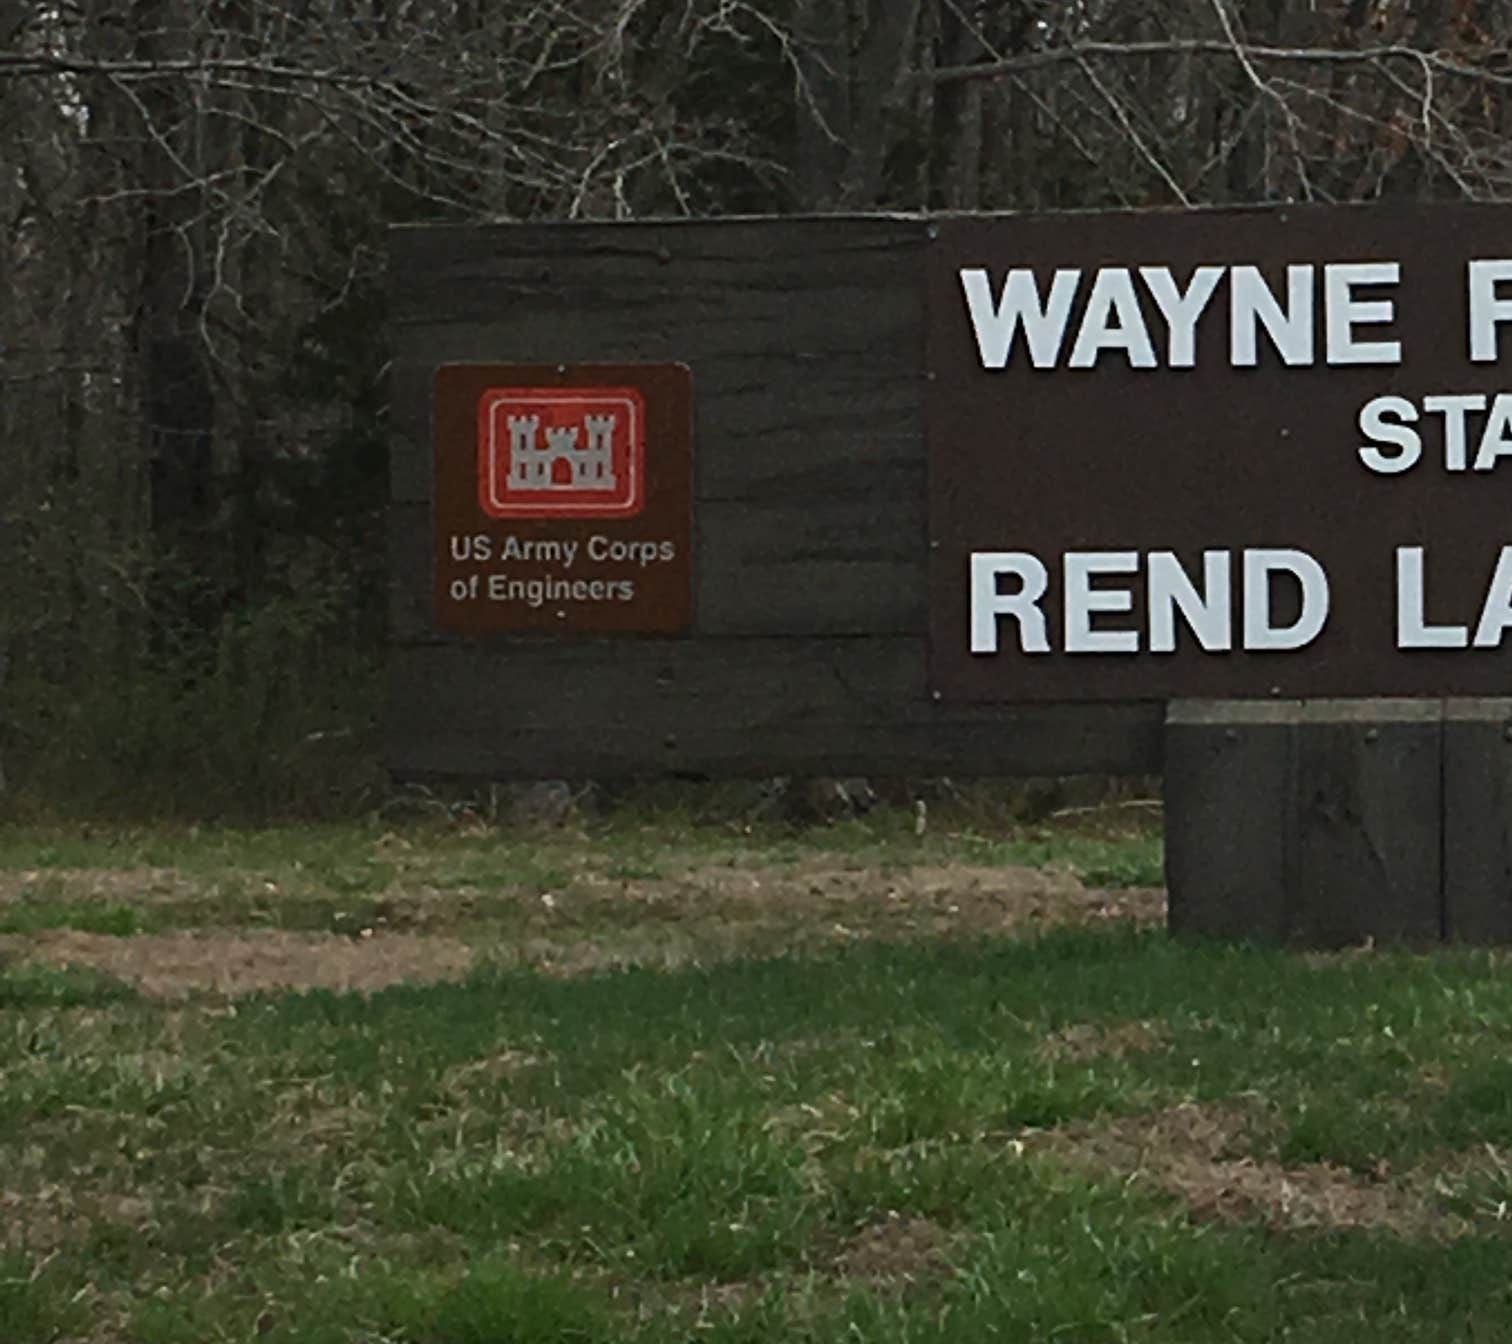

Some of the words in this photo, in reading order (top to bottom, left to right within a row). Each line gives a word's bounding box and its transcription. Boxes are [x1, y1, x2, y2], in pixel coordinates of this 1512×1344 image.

[959, 262, 1402, 368] WAYNE
[451, 534, 492, 561] US
[500, 535, 579, 568] Army
[587, 535, 675, 567] Corps
[450, 574, 479, 601] of
[488, 574, 635, 608] Engineers
[970, 548, 1330, 653] REND
